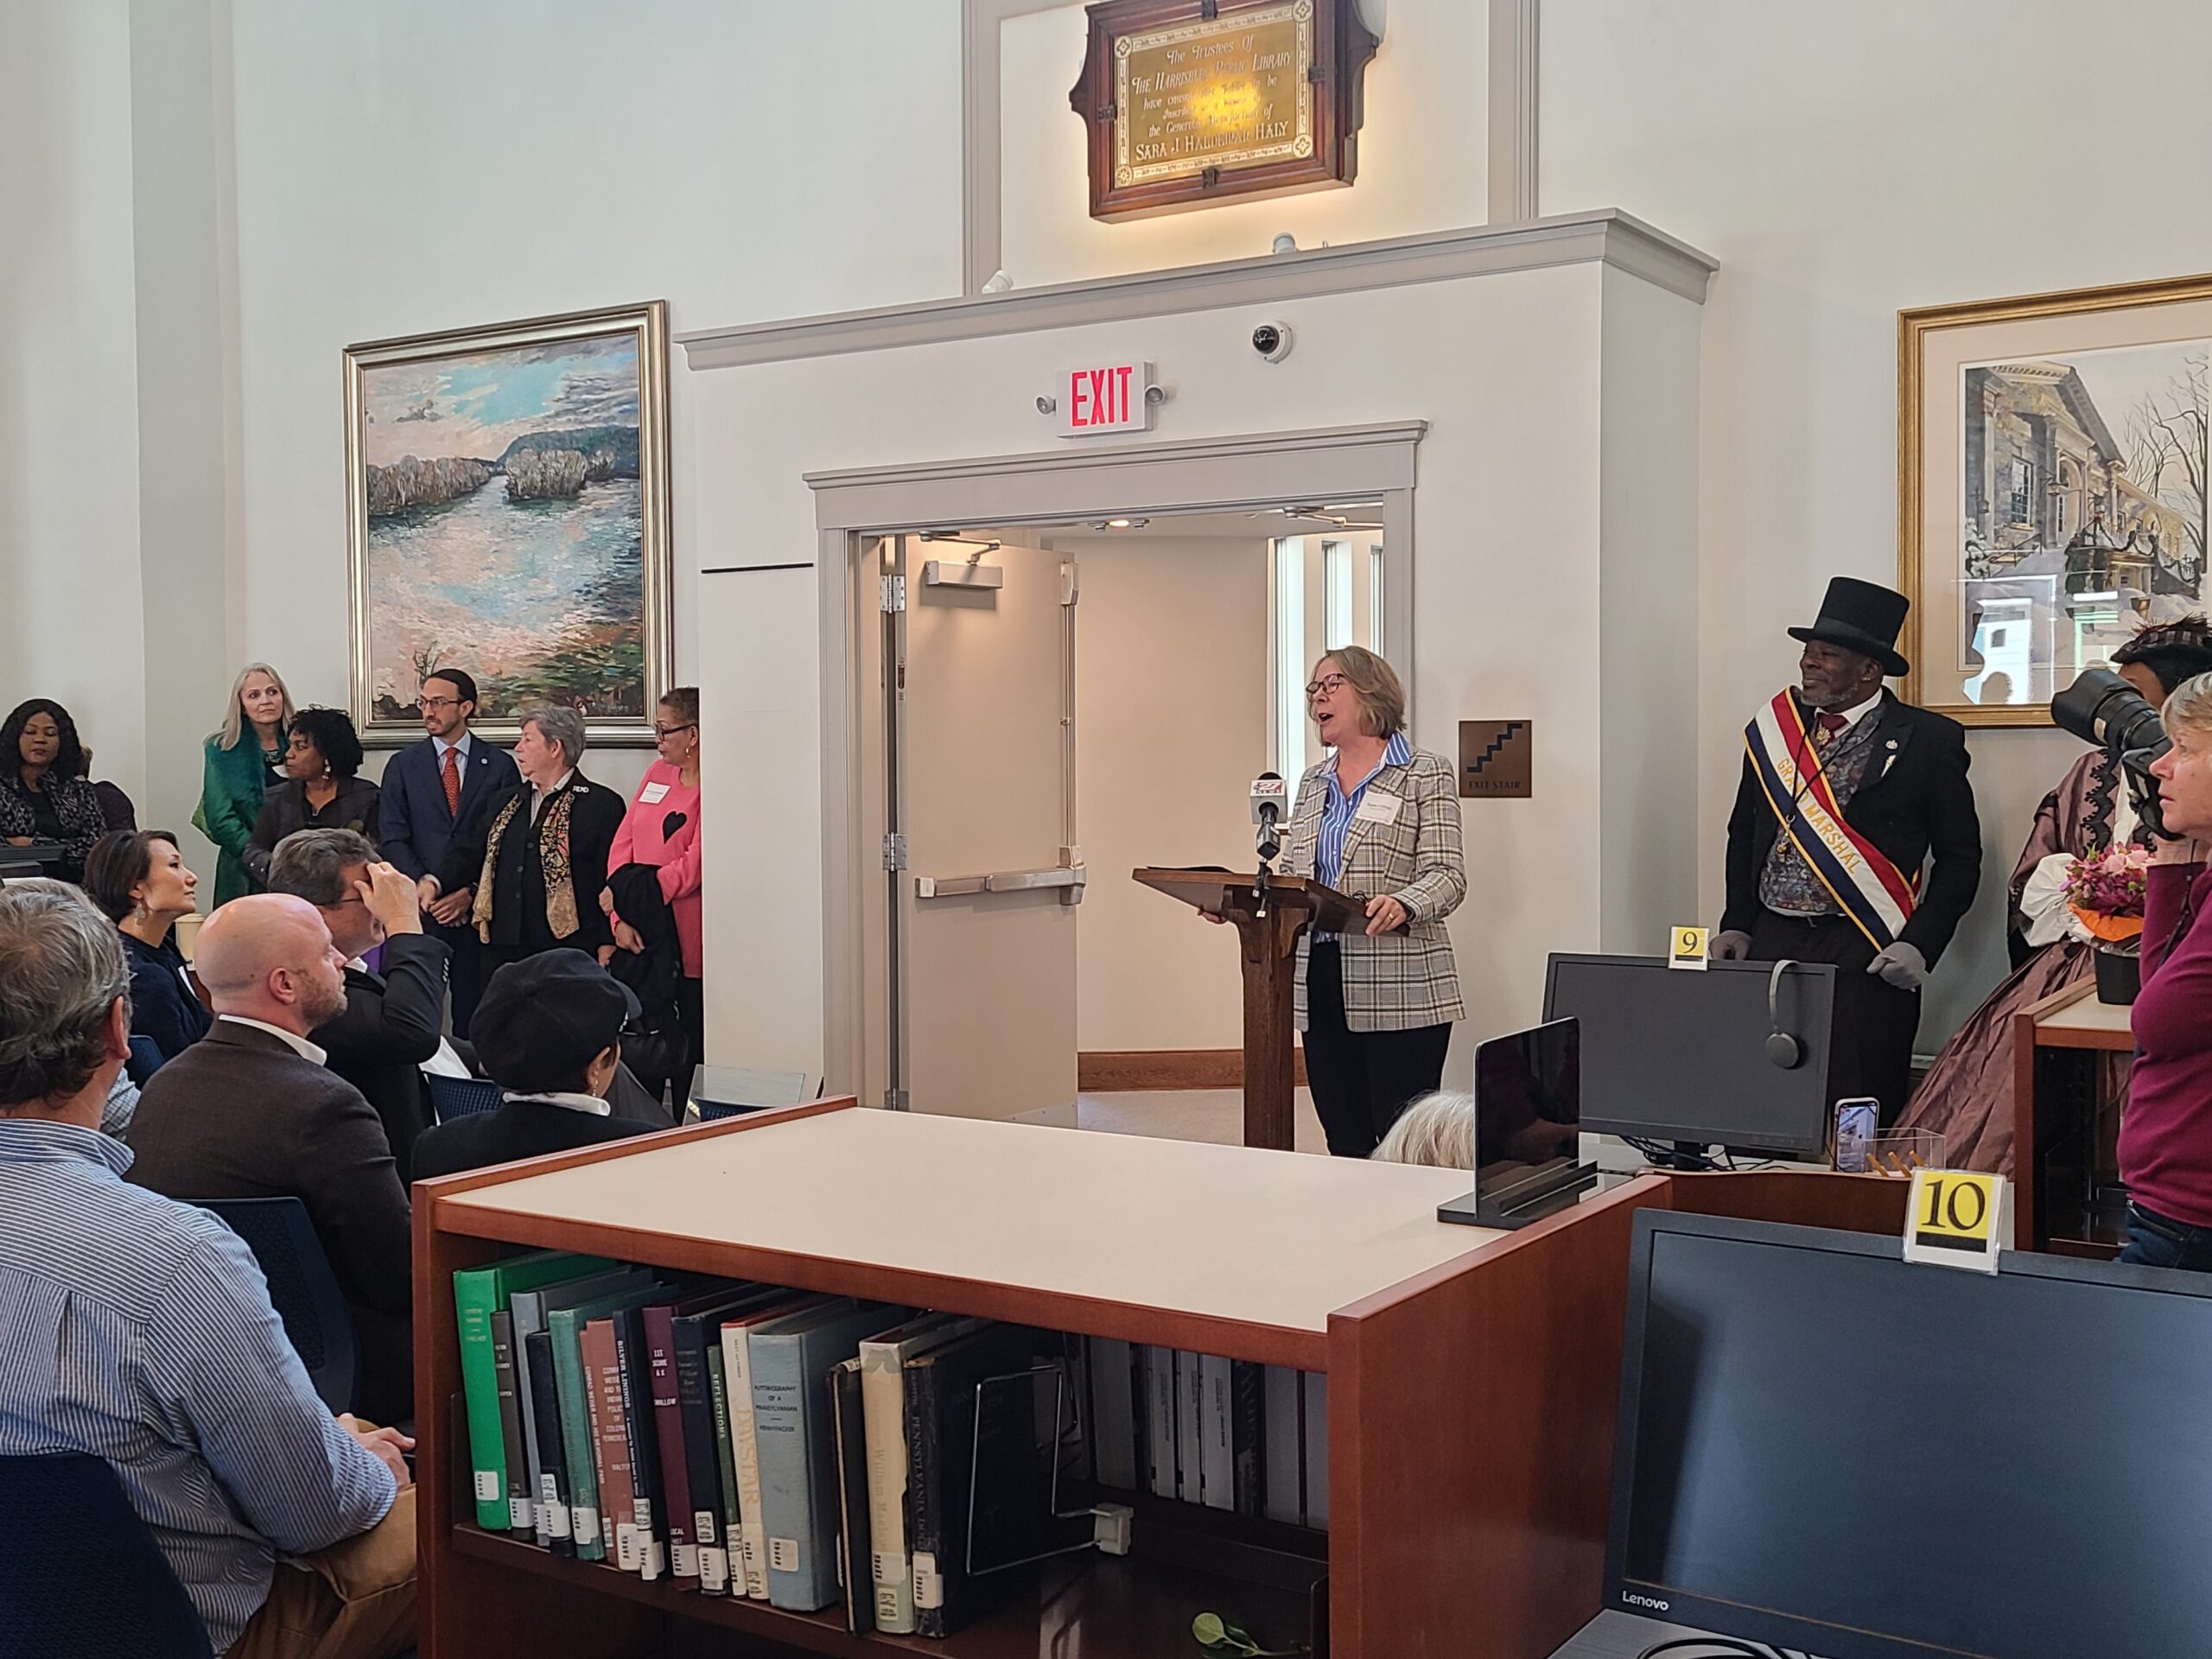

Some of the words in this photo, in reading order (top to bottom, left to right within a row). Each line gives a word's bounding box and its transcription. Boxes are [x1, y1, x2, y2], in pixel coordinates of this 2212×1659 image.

[1192, 41, 1234, 60] Trustees
[1252, 51, 1293, 72] LIBRARY
[1143, 98, 1162, 111] have
[1148, 126, 1160, 138] the
[1263, 104, 1274, 120] of
[1255, 121, 1289, 140] HALY
[1071, 366, 1132, 427] EXIT
[1804, 803, 1861, 874] MARSHAL
[1682, 931, 1698, 954] 9
[1921, 1179, 1986, 1231] 10
[617, 1340, 626, 1372] SILVER
[620, 1372, 632, 1408] LININGS
[713, 1373, 726, 1439] REFLECTIONS
[1623, 1590, 1669, 1611] Lenovo
